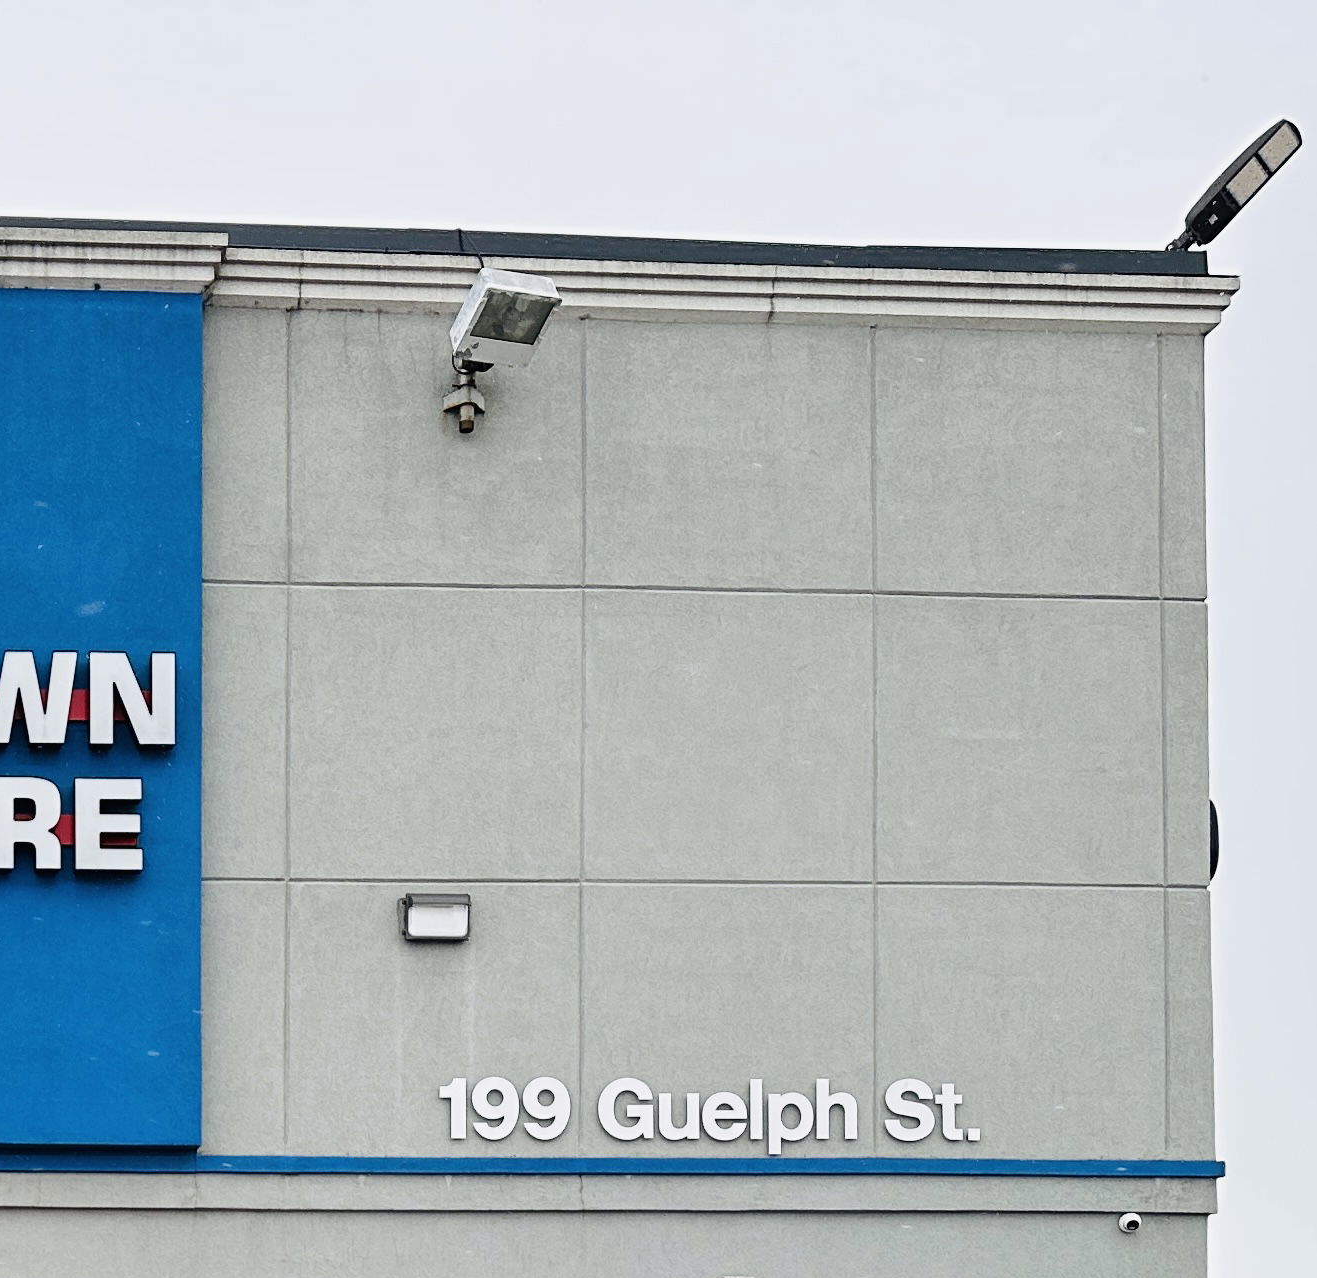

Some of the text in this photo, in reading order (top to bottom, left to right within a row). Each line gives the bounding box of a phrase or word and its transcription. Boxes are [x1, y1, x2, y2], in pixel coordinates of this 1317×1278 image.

[439, 1076, 982, 1155] 199 Guelph St.
